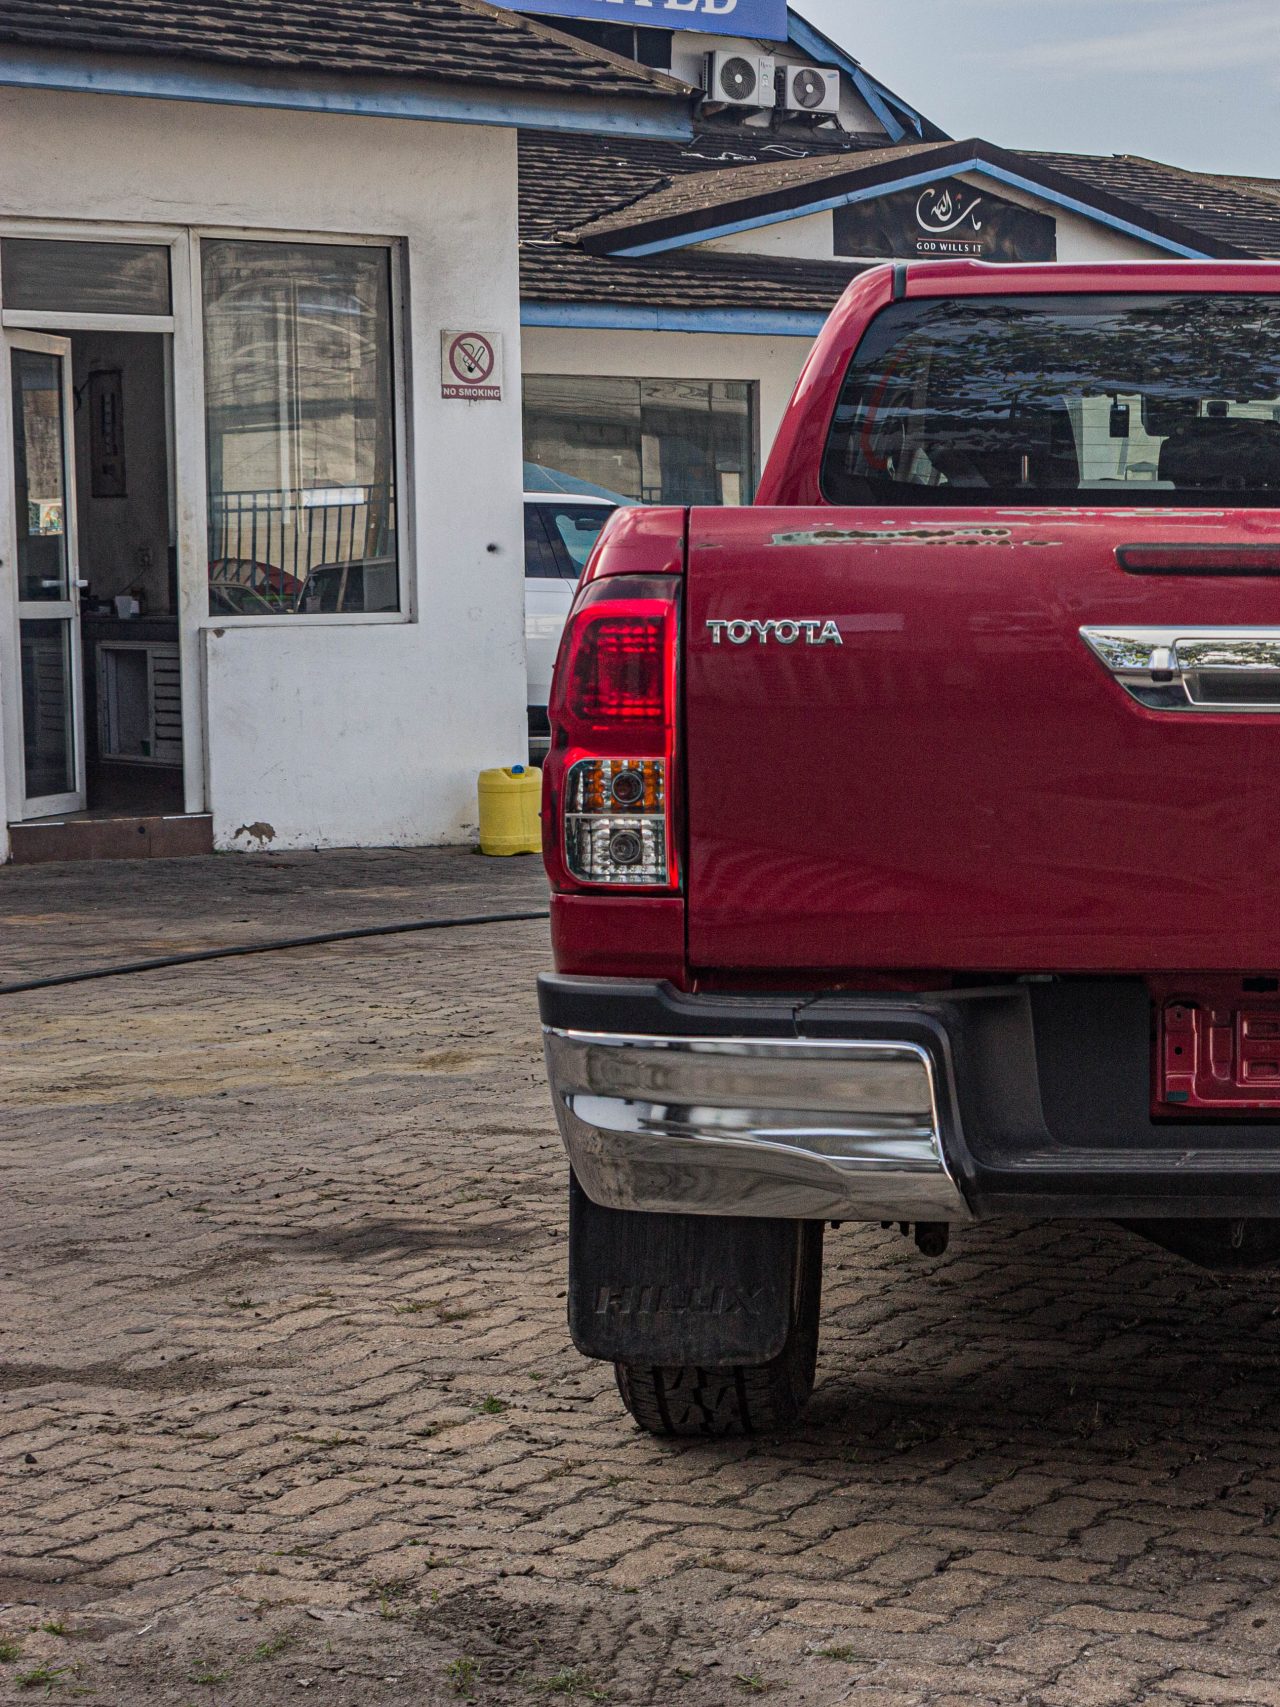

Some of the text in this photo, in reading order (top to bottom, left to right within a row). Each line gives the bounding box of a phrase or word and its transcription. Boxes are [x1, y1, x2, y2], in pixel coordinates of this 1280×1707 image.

[916, 242, 982, 252] GOD WILLS IT
[443, 387, 500, 397] NO SMOKING
[706, 619, 843, 645] TOYOTA
[594, 1285, 767, 1315] HILUX
